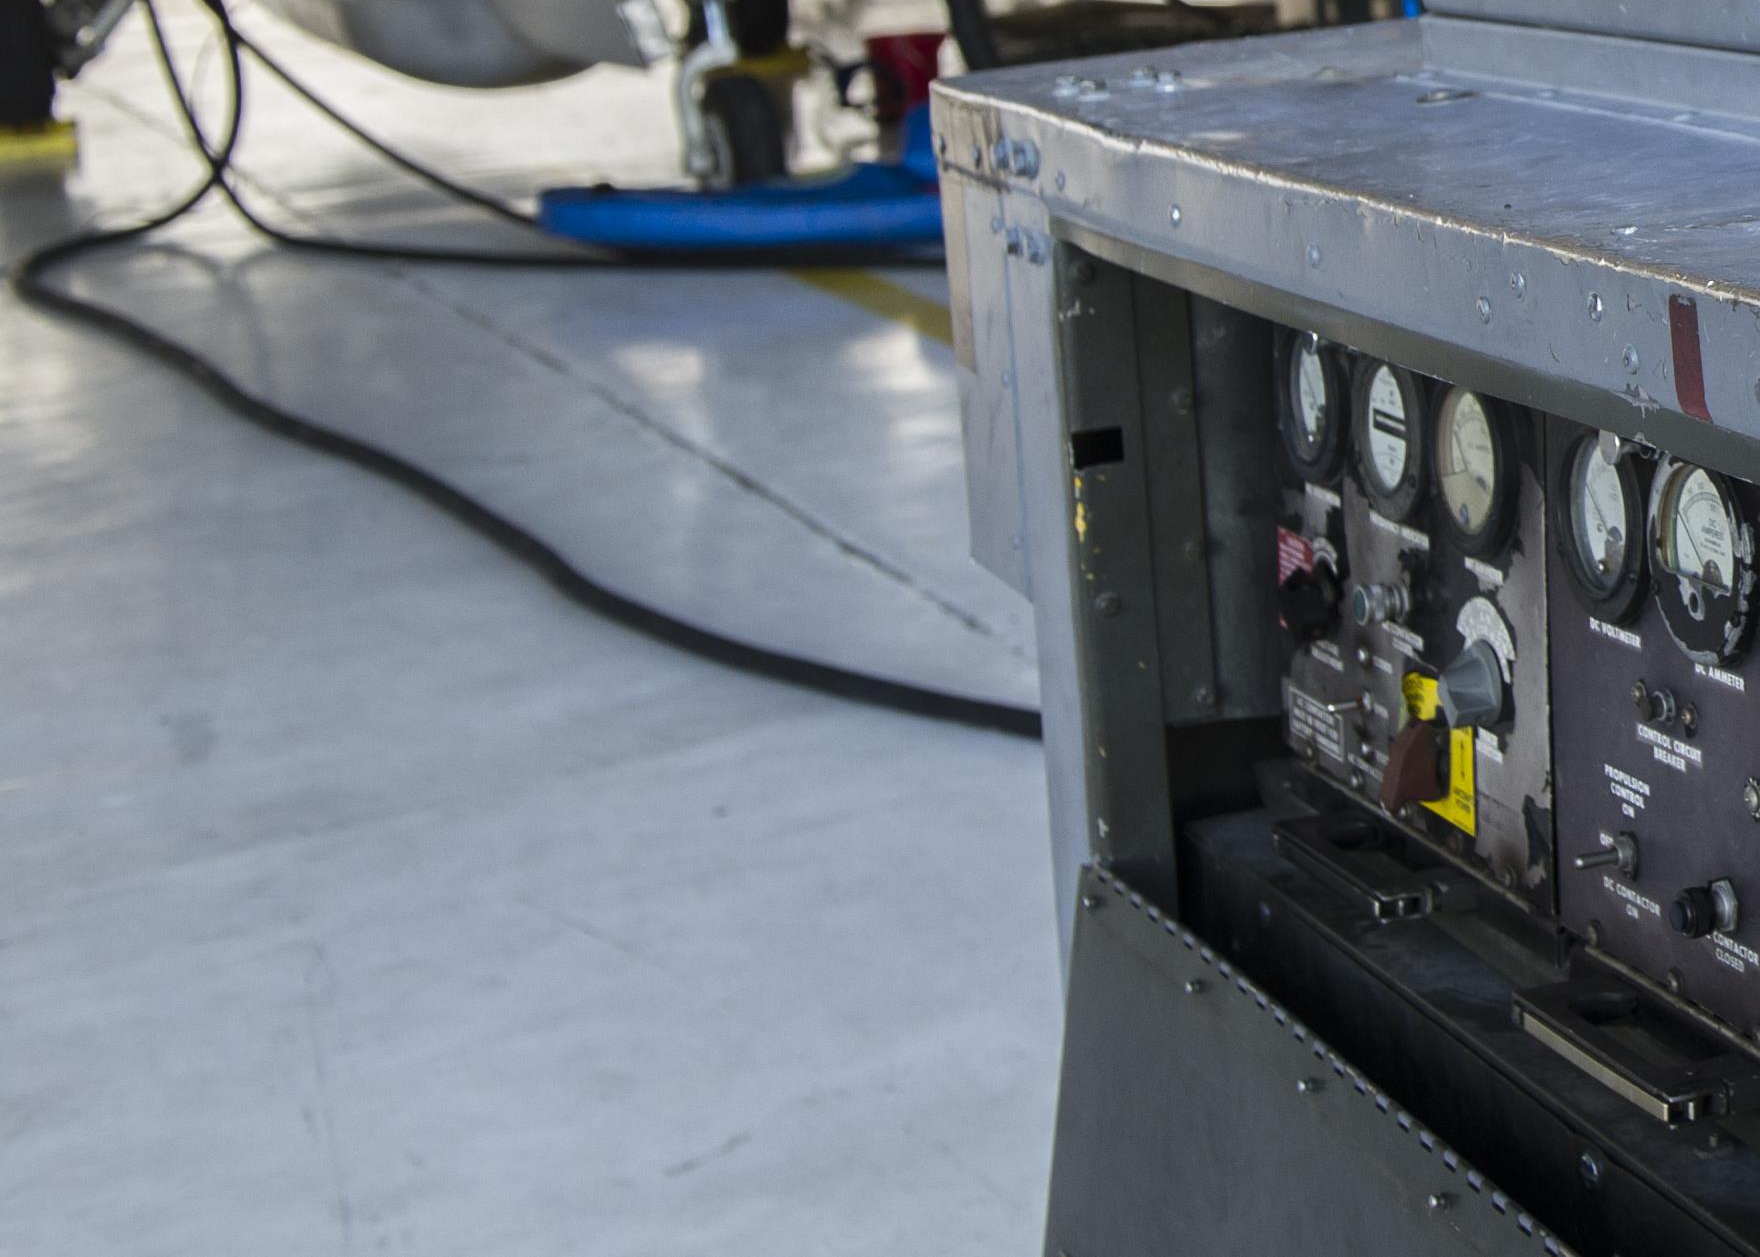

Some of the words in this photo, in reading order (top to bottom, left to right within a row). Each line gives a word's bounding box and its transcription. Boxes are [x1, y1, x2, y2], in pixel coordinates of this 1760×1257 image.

[1589, 616, 1600, 632] DC
[1601, 621, 1642, 648] VOLTMETER
[1708, 666, 1745, 692] AMMETER
[1637, 723, 1672, 750] CONTROL
[1673, 740, 1702, 762] CIRCUIT
[1653, 746, 1686, 772] BREAKER
[1604, 763, 1651, 797] PROPULSION
[1610, 781, 1646, 809] CONTROL
[1622, 802, 1635, 818] ON
[1603, 875, 1615, 892] DC
[1616, 882, 1661, 917] CONTACTOR
[1626, 903, 1639, 919] ON
[1713, 930, 1760, 966] CONTACTOR
[1715, 947, 1745, 973] CLOSED
